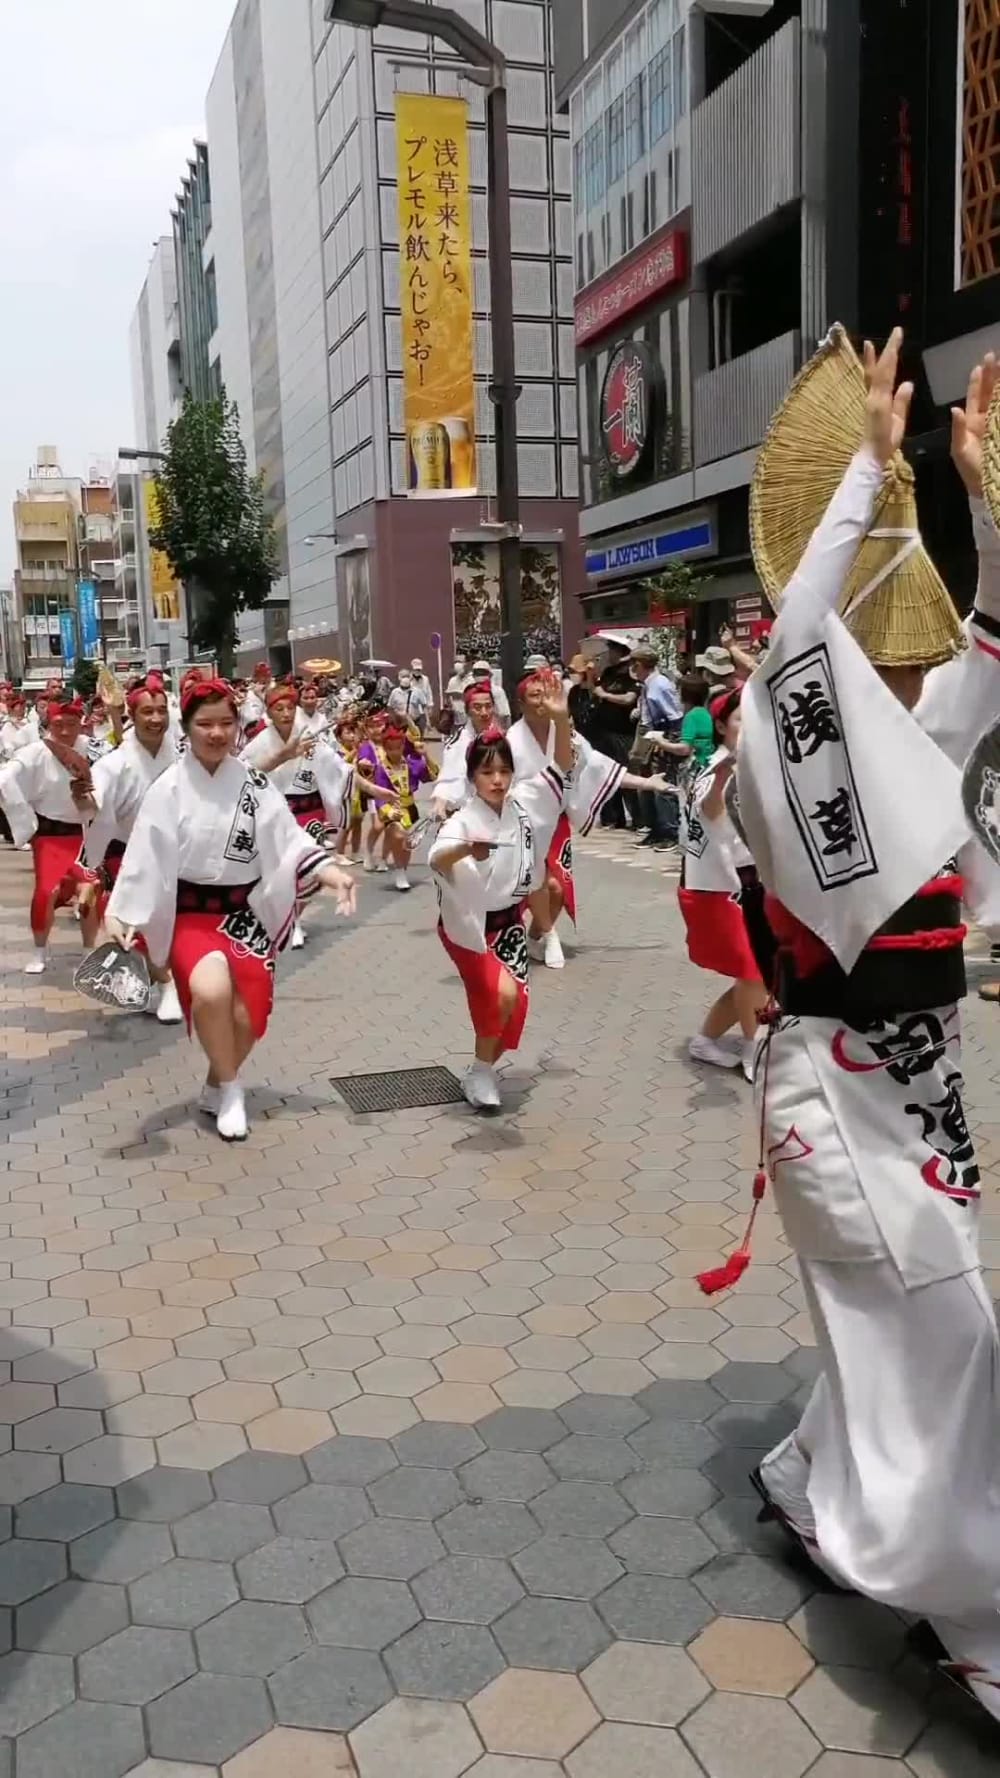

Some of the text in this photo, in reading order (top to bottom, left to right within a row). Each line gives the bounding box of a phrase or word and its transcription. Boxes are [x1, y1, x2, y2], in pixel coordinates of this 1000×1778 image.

[433, 138, 462, 293] 浅草来たら、
[608, 538, 655, 568] LAWSON
